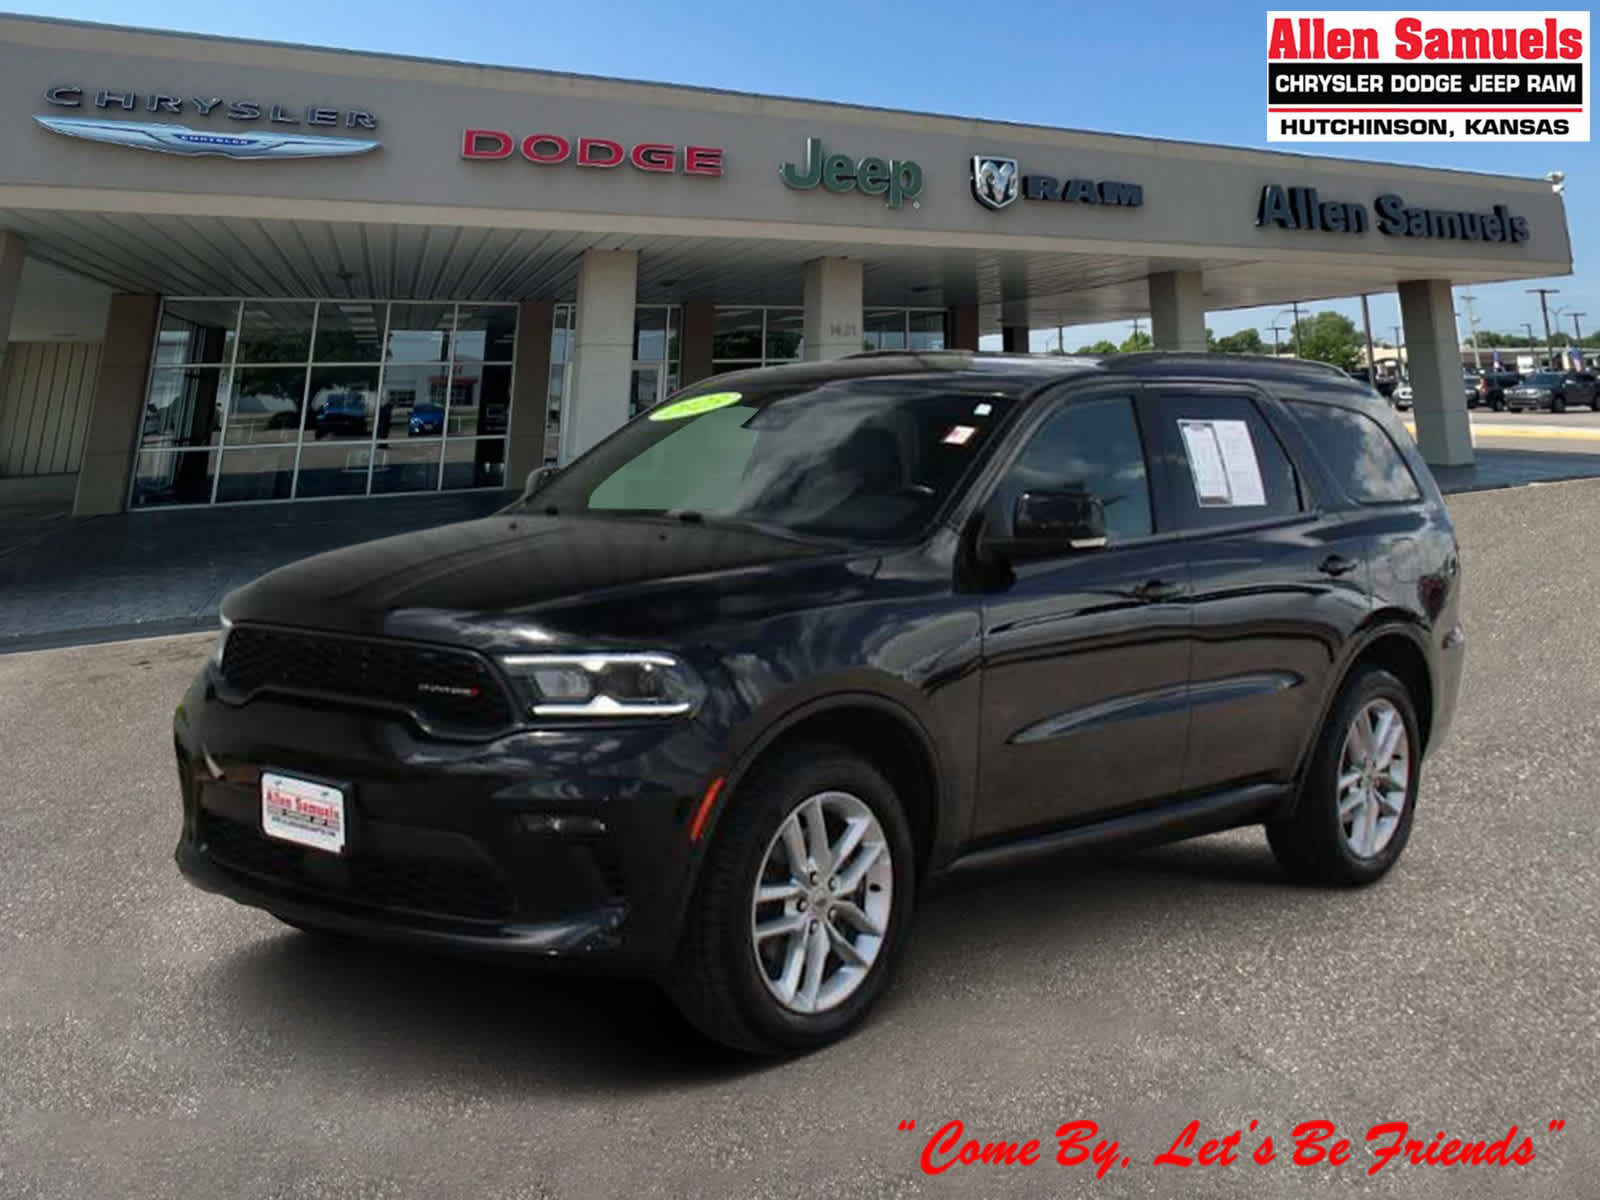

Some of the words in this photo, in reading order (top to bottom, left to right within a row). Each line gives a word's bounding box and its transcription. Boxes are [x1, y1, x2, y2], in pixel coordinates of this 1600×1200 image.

[44, 86, 378, 130] CHRYSLER
[461, 128, 724, 177] DODGE
[779, 136, 924, 209] Jeep
[1022, 175, 1144, 207] RAM
[1256, 184, 1370, 233] Allen
[1374, 194, 1531, 243] Samuels
